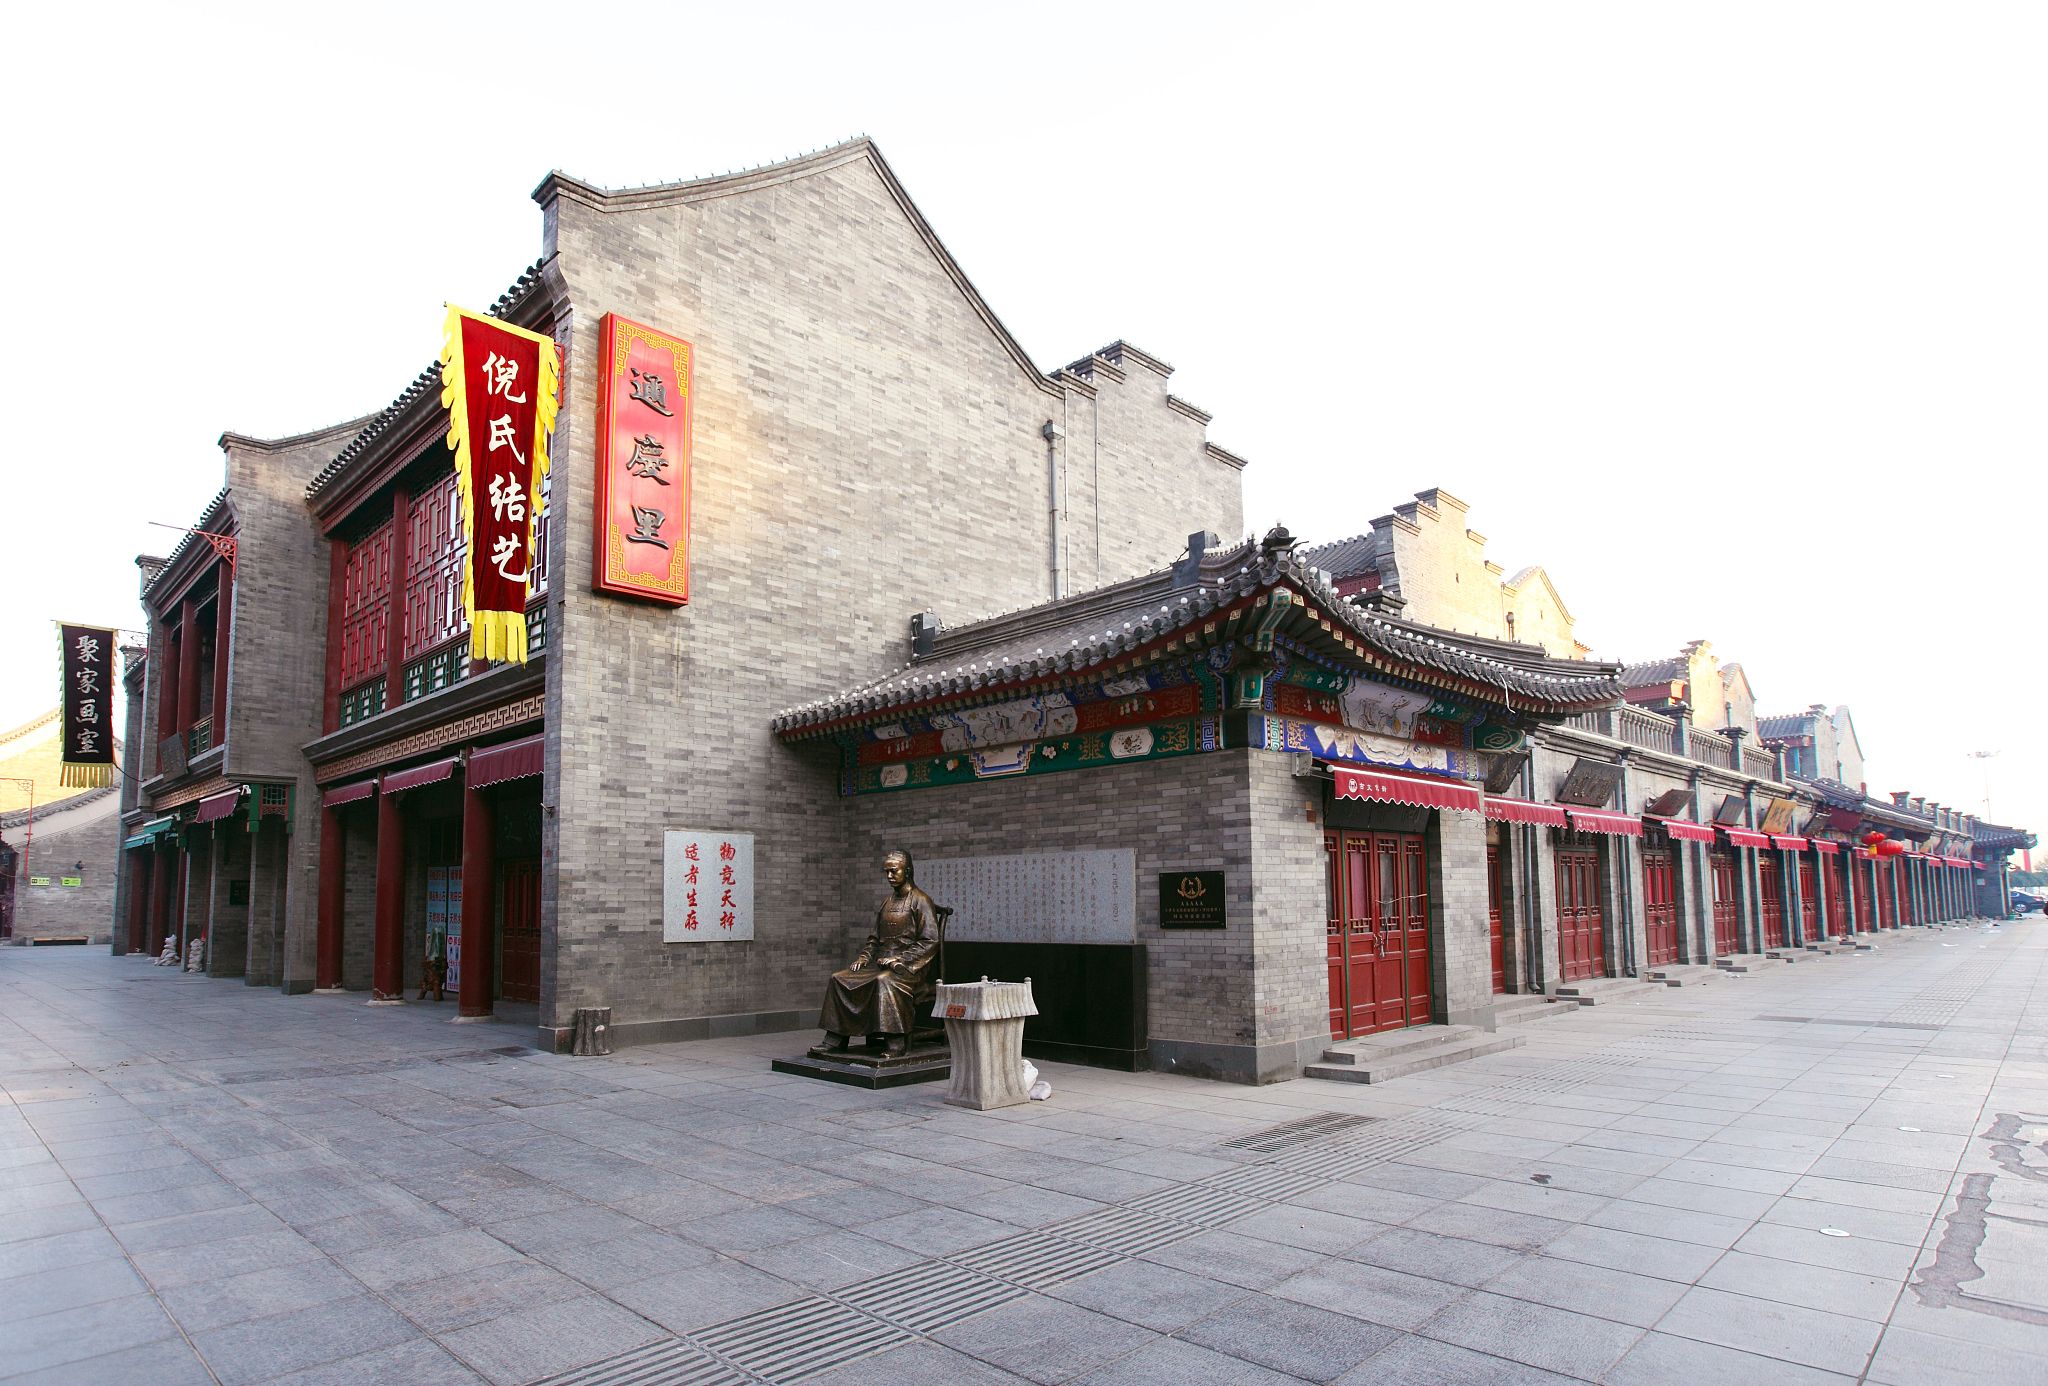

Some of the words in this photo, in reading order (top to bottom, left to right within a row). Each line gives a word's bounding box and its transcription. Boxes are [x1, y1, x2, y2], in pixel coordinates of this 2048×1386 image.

[481, 350, 528, 583] 倪氏结艺
[625, 367, 675, 550] 通慶里
[75, 635, 100, 754] 聚家画室
[685, 842, 700, 930] 适者生存
[719, 842, 736, 931] 物竞天择
